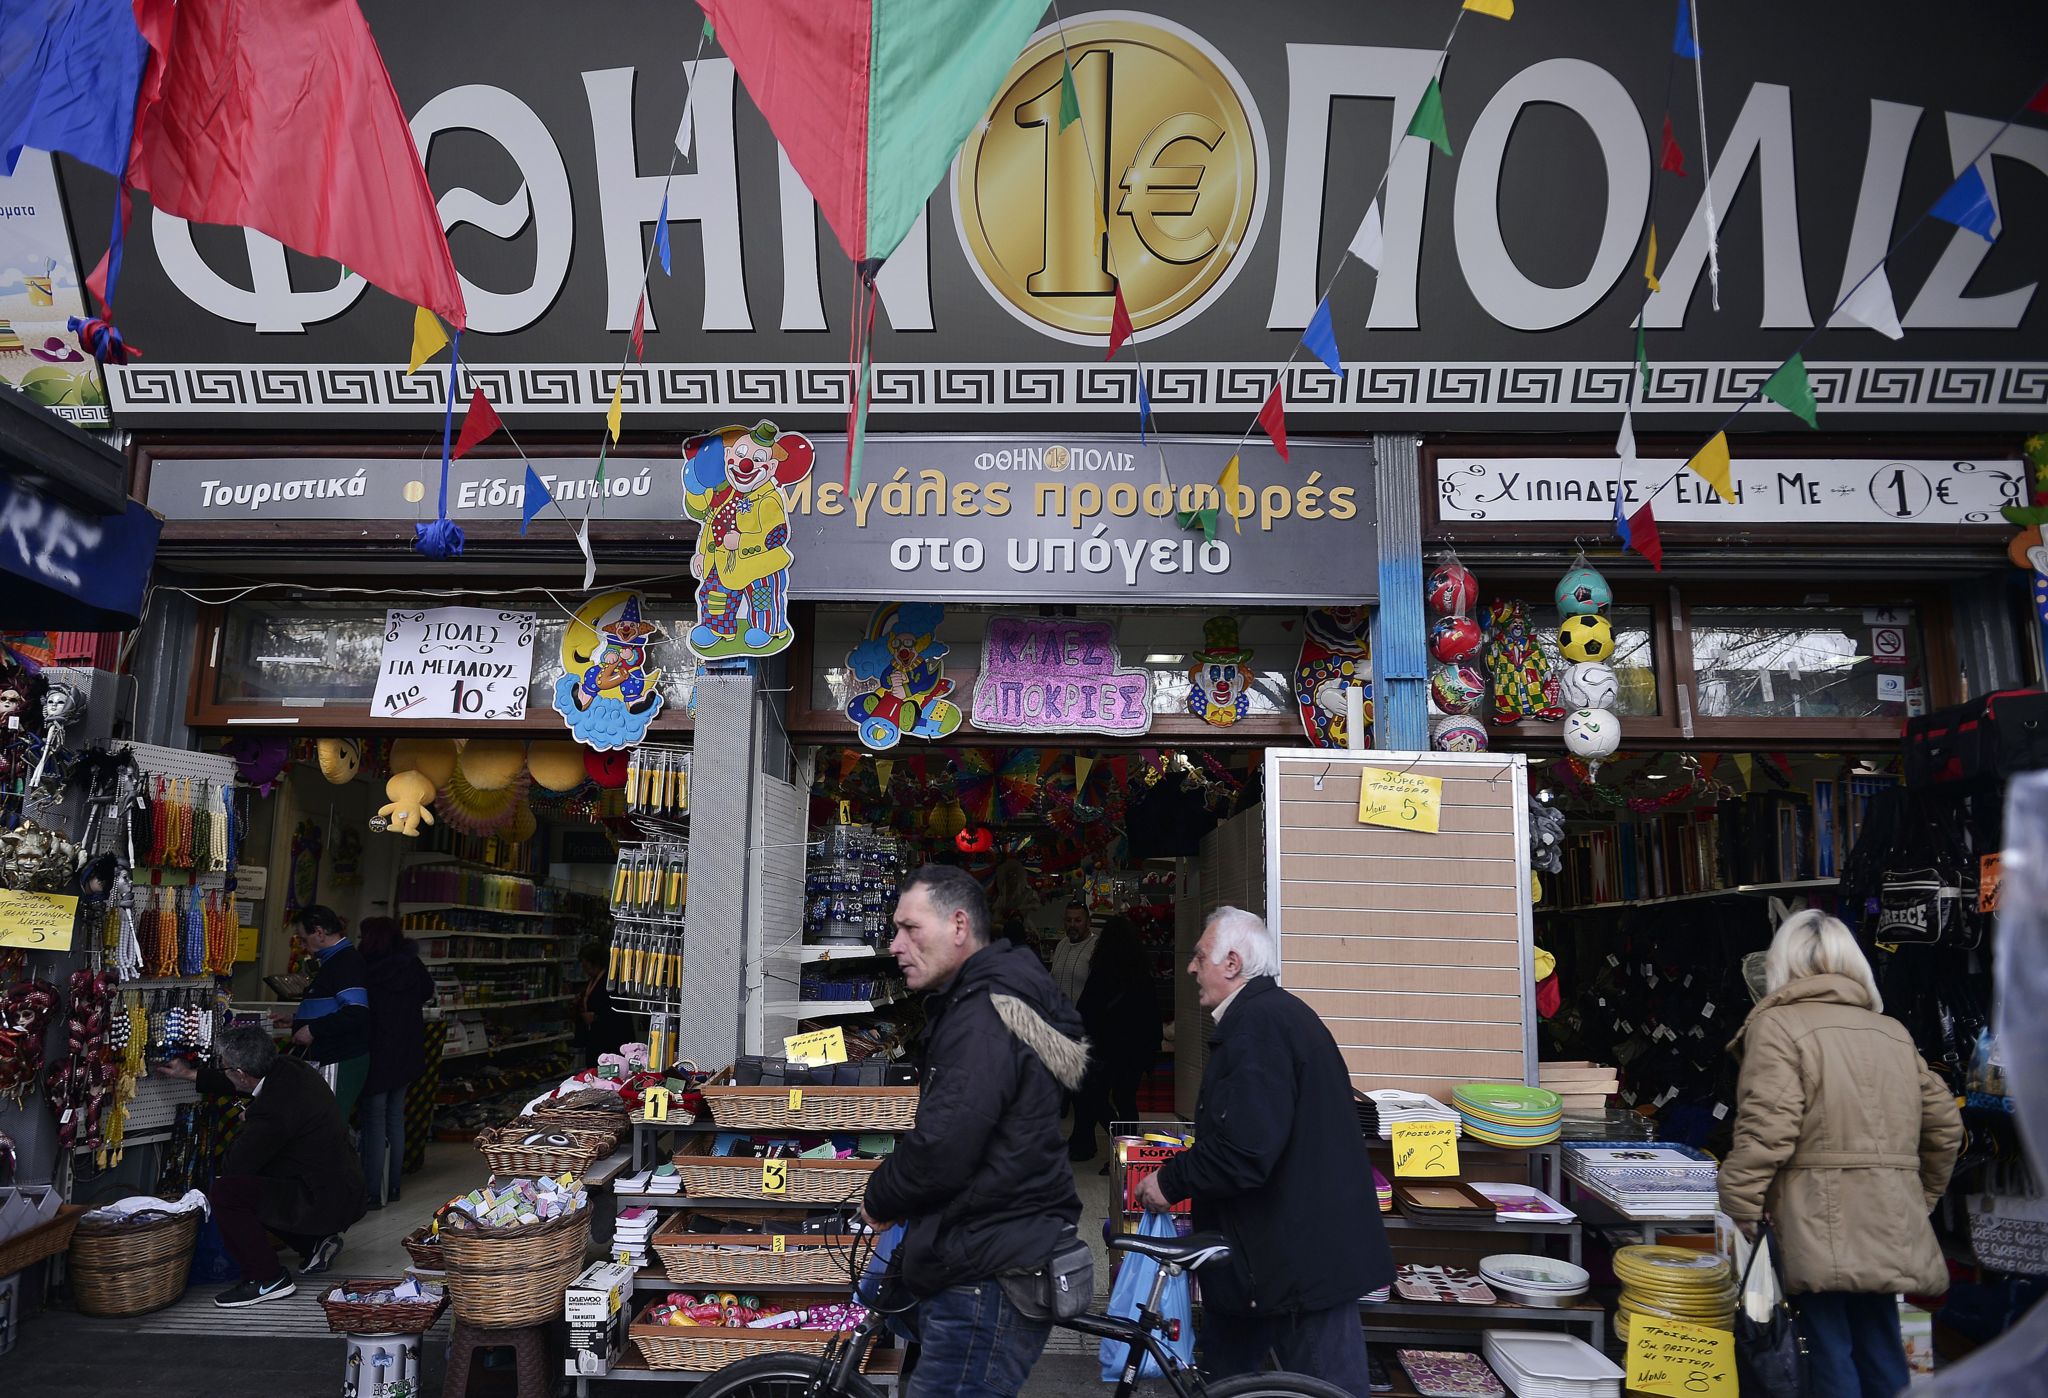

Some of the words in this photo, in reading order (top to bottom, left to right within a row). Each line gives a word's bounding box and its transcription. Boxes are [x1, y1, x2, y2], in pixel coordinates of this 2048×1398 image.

[201, 469, 367, 511] Τουριστικά
[457, 478, 526, 509] Είδη
[1034, 470, 1358, 531] προσφορές
[889, 535, 985, 573] στο
[1008, 523, 1231, 585] υπόγειο
[421, 622, 506, 644] ΣΤΟΛΕΣ
[1000, 629, 1103, 666] ΚΑΛΕΣ
[421, 659, 518, 679] ΜΕΓΑΛΟΥΣ
[981, 681, 1141, 721] ΑΠΟΚΡΙΕΣ
